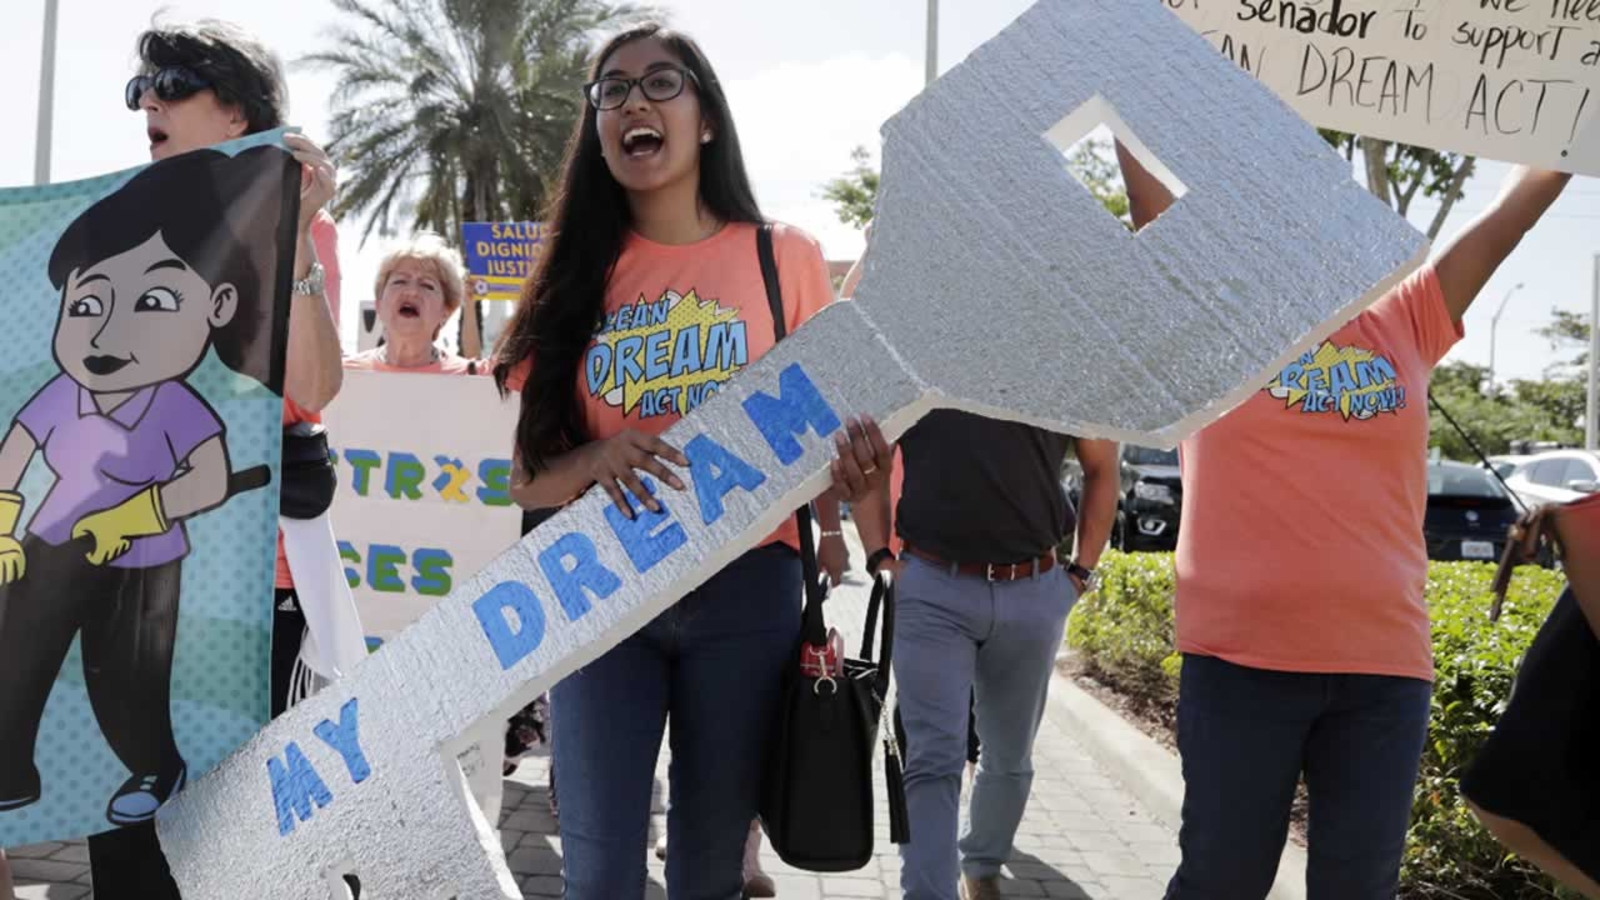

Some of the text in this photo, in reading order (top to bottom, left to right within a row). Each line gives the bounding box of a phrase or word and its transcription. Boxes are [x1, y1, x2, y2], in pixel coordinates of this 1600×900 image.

[1297, 42, 1434, 125] DREAM
[1464, 73, 1590, 158] ACT!
[602, 299, 671, 333] LEAN
[585, 320, 749, 397] DREAM
[1278, 355, 1397, 397] REAM
[639, 379, 727, 418] ACT NO
[1301, 387, 1407, 413] ACT NOW!
[328, 448, 517, 507] TRXS
[266, 361, 842, 837] MY DREAM
